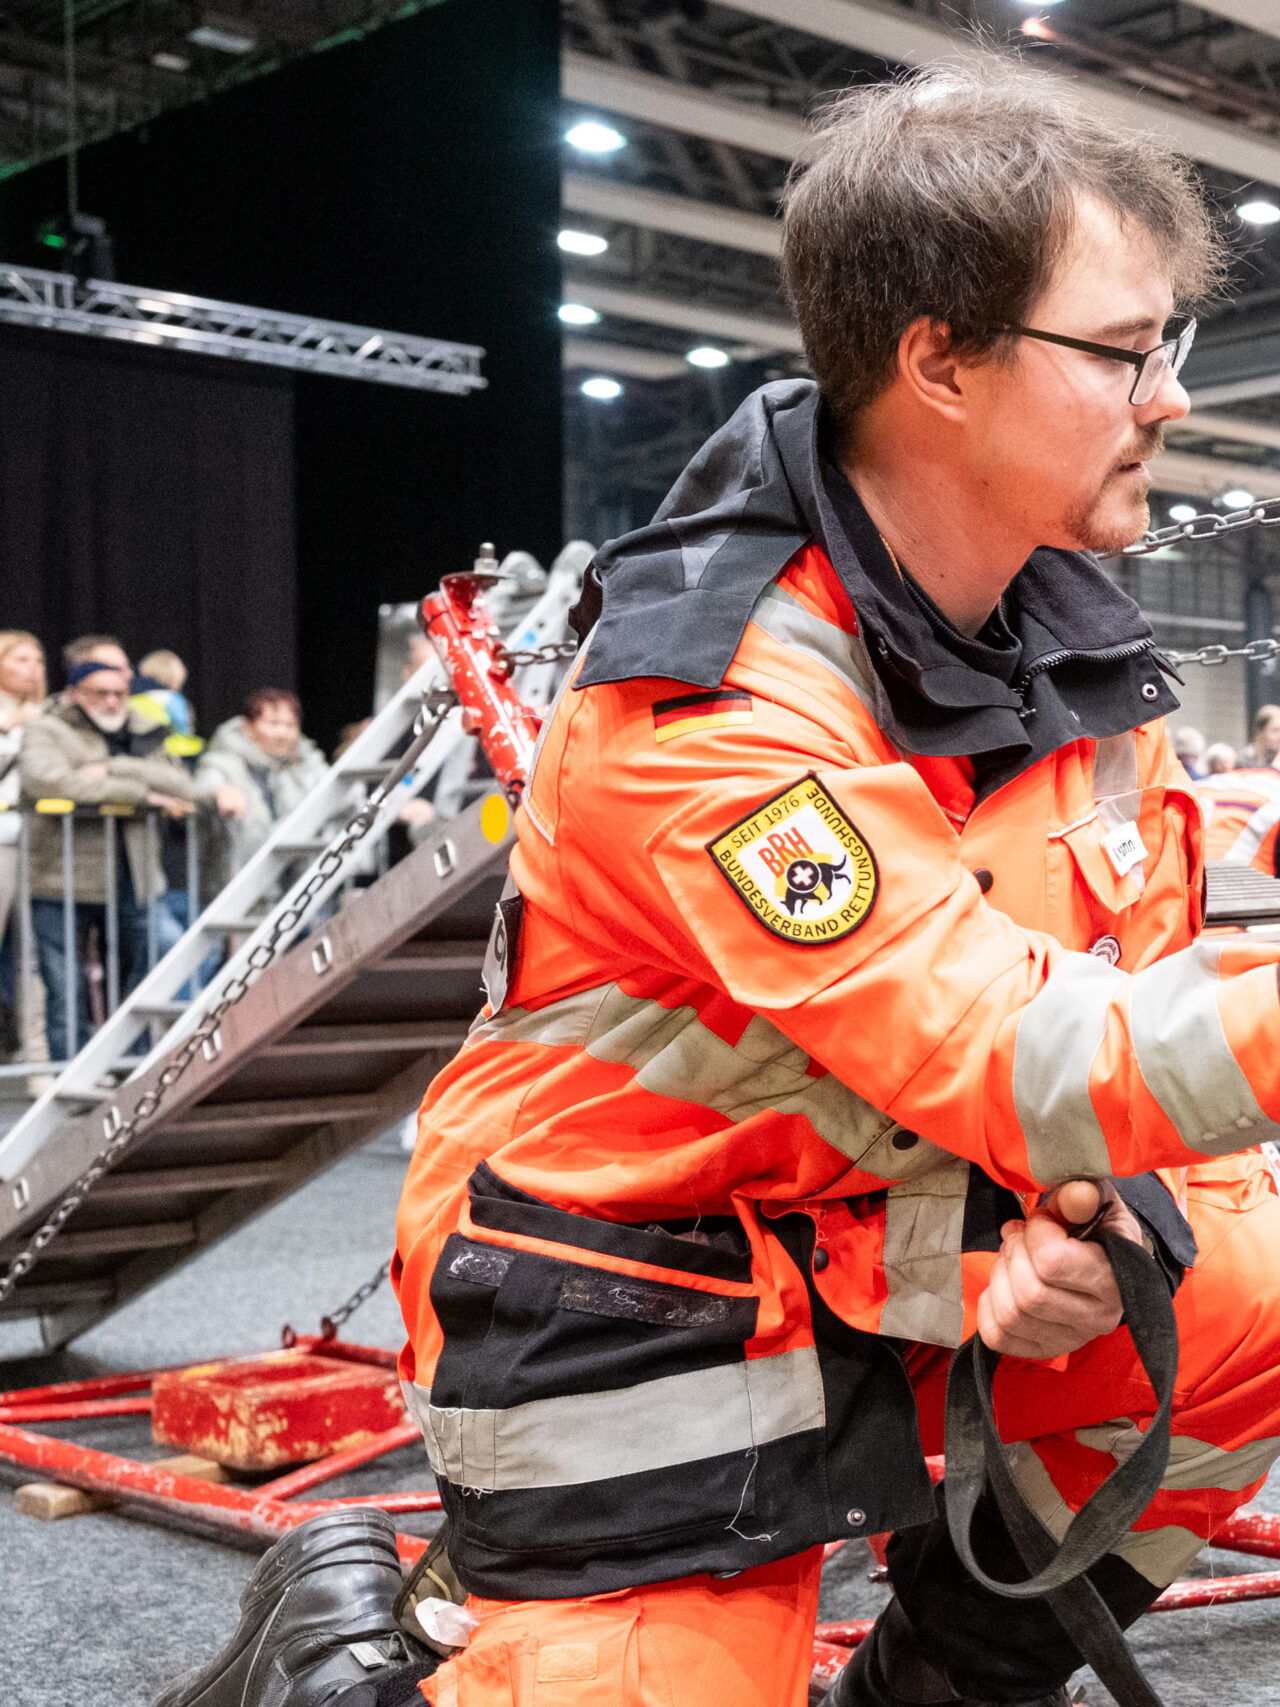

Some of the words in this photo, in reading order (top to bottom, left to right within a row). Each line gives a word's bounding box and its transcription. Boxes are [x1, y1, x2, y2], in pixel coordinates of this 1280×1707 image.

[731, 820, 762, 849] SEIT
[764, 794, 800, 826] 1976
[719, 850, 839, 937] BUNDESVERBAND
[806, 787, 872, 923] RETTUNGSHUNDE
[757, 826, 814, 879] BRH
